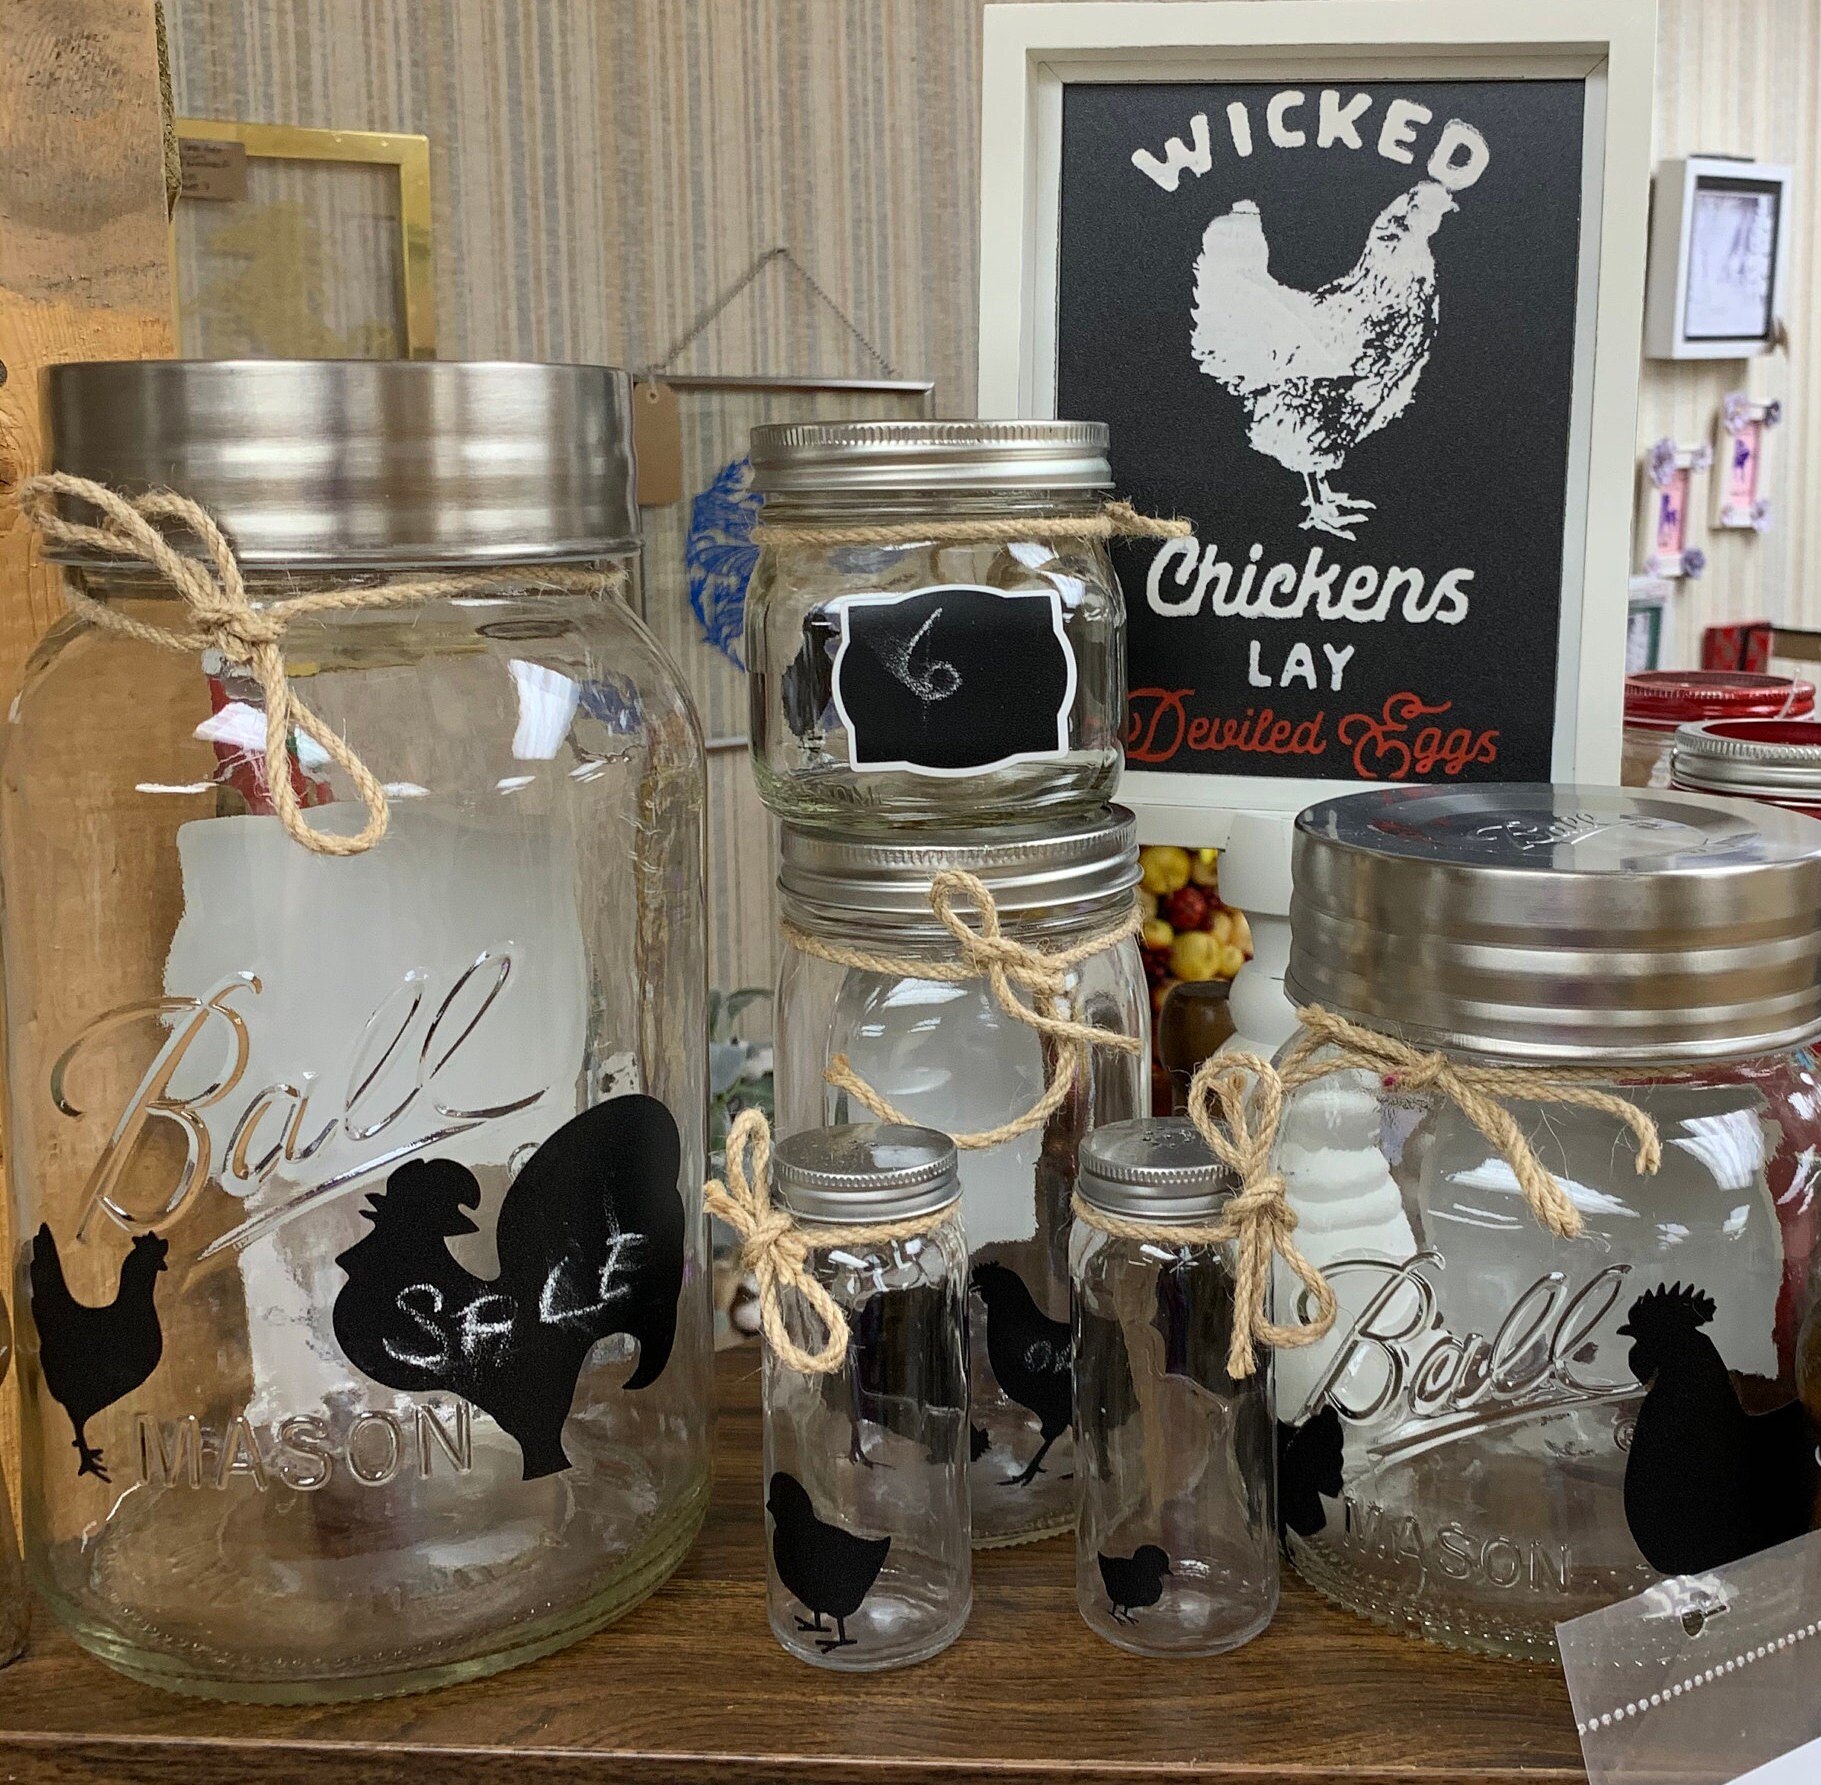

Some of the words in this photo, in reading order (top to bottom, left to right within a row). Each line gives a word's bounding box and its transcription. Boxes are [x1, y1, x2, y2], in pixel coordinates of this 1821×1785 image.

[1131, 89, 1490, 192] WICKED
[1146, 536, 1475, 624] Chickens
[886, 606, 964, 702] 6
[1248, 640, 1355, 691] LAY
[1126, 687, 1327, 763] Deviled
[1337, 691, 1500, 779] Eggs
[49, 940, 550, 1246] Ball
[1289, 1248, 1650, 1428] Ball
[132, 1400, 473, 1493] MASON
[1341, 1495, 1572, 1596] MASON
